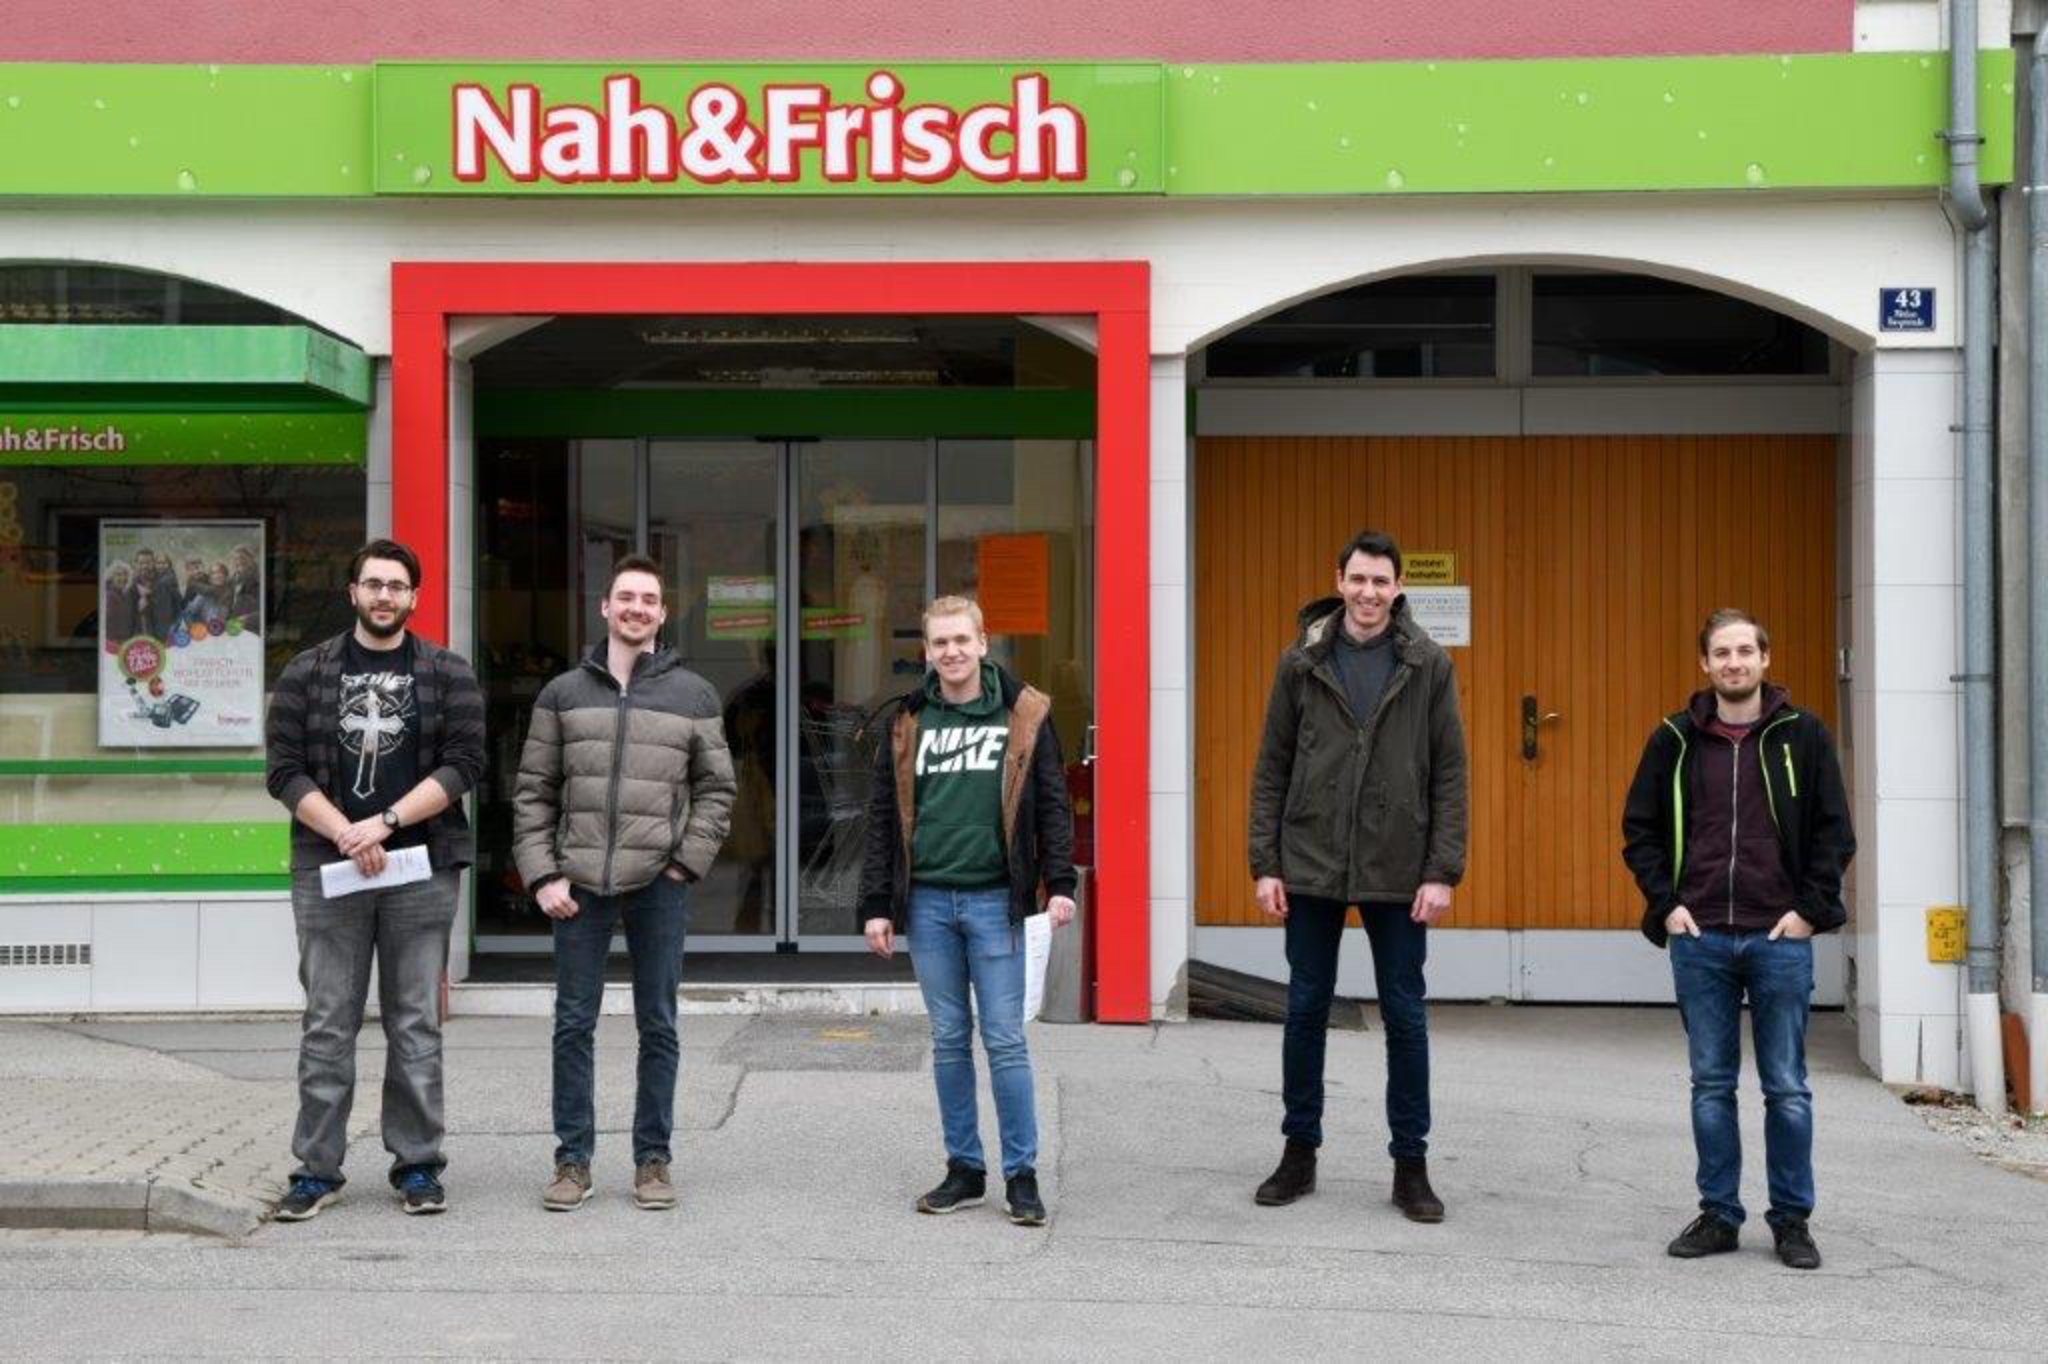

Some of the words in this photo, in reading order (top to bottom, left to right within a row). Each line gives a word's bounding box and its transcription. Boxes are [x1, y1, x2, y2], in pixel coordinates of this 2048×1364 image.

[452, 71, 1087, 183] Nah&Frisch
[1895, 289, 1921, 308] 43
[0, 425, 126, 452] h&Frisch
[915, 726, 1009, 776] NIKE
